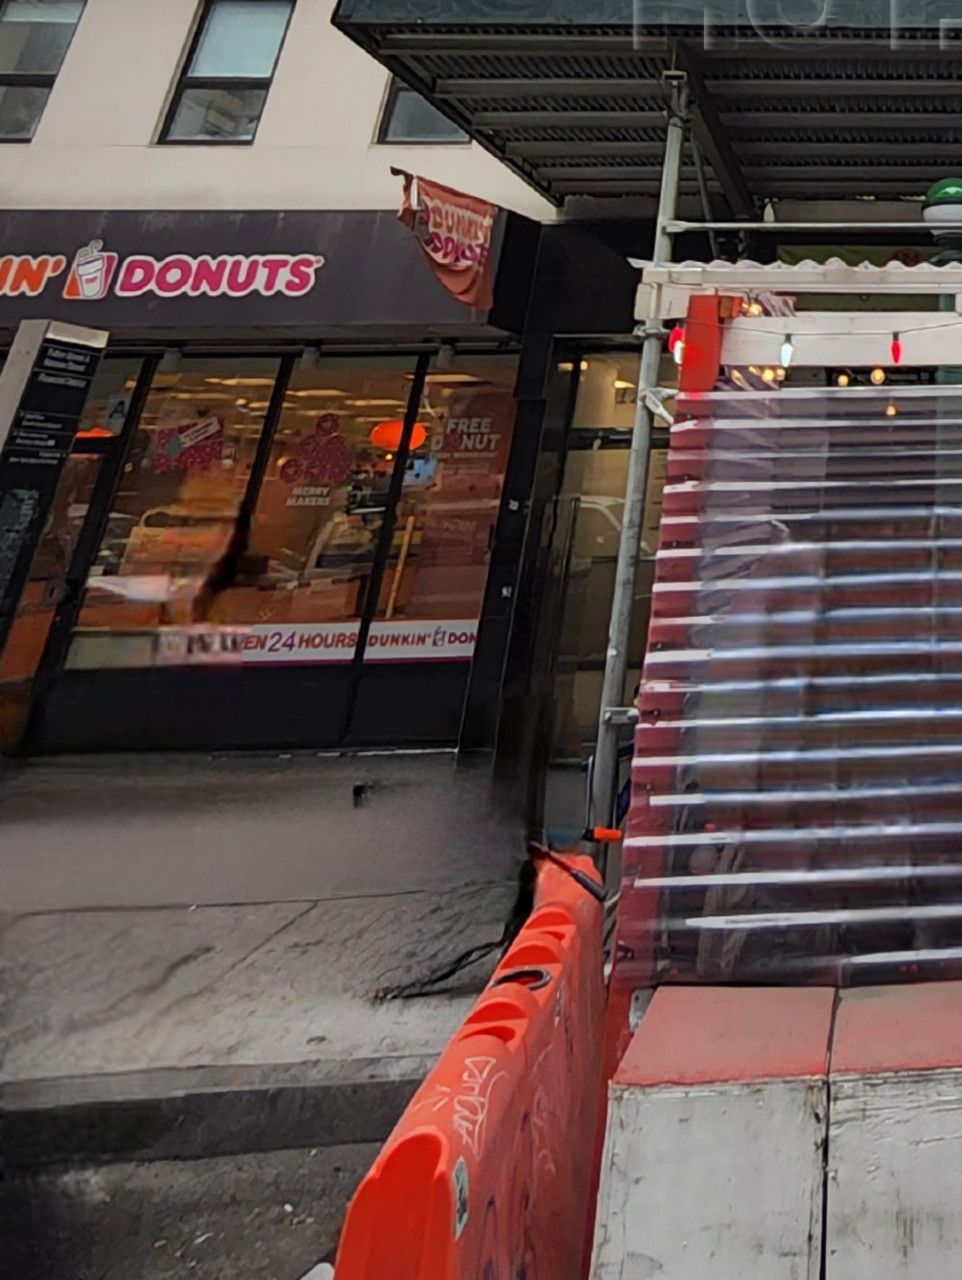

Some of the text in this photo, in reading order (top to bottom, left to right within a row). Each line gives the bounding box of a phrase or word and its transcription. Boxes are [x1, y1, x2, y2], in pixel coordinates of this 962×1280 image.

[117, 256, 317, 294] DONUTS
[108, 400, 125, 419] A
[446, 417, 493, 433] FREE
[268, 631, 297, 653] 24
[299, 630, 358, 648] HOURS
[368, 632, 431, 647] DUNKIN'
